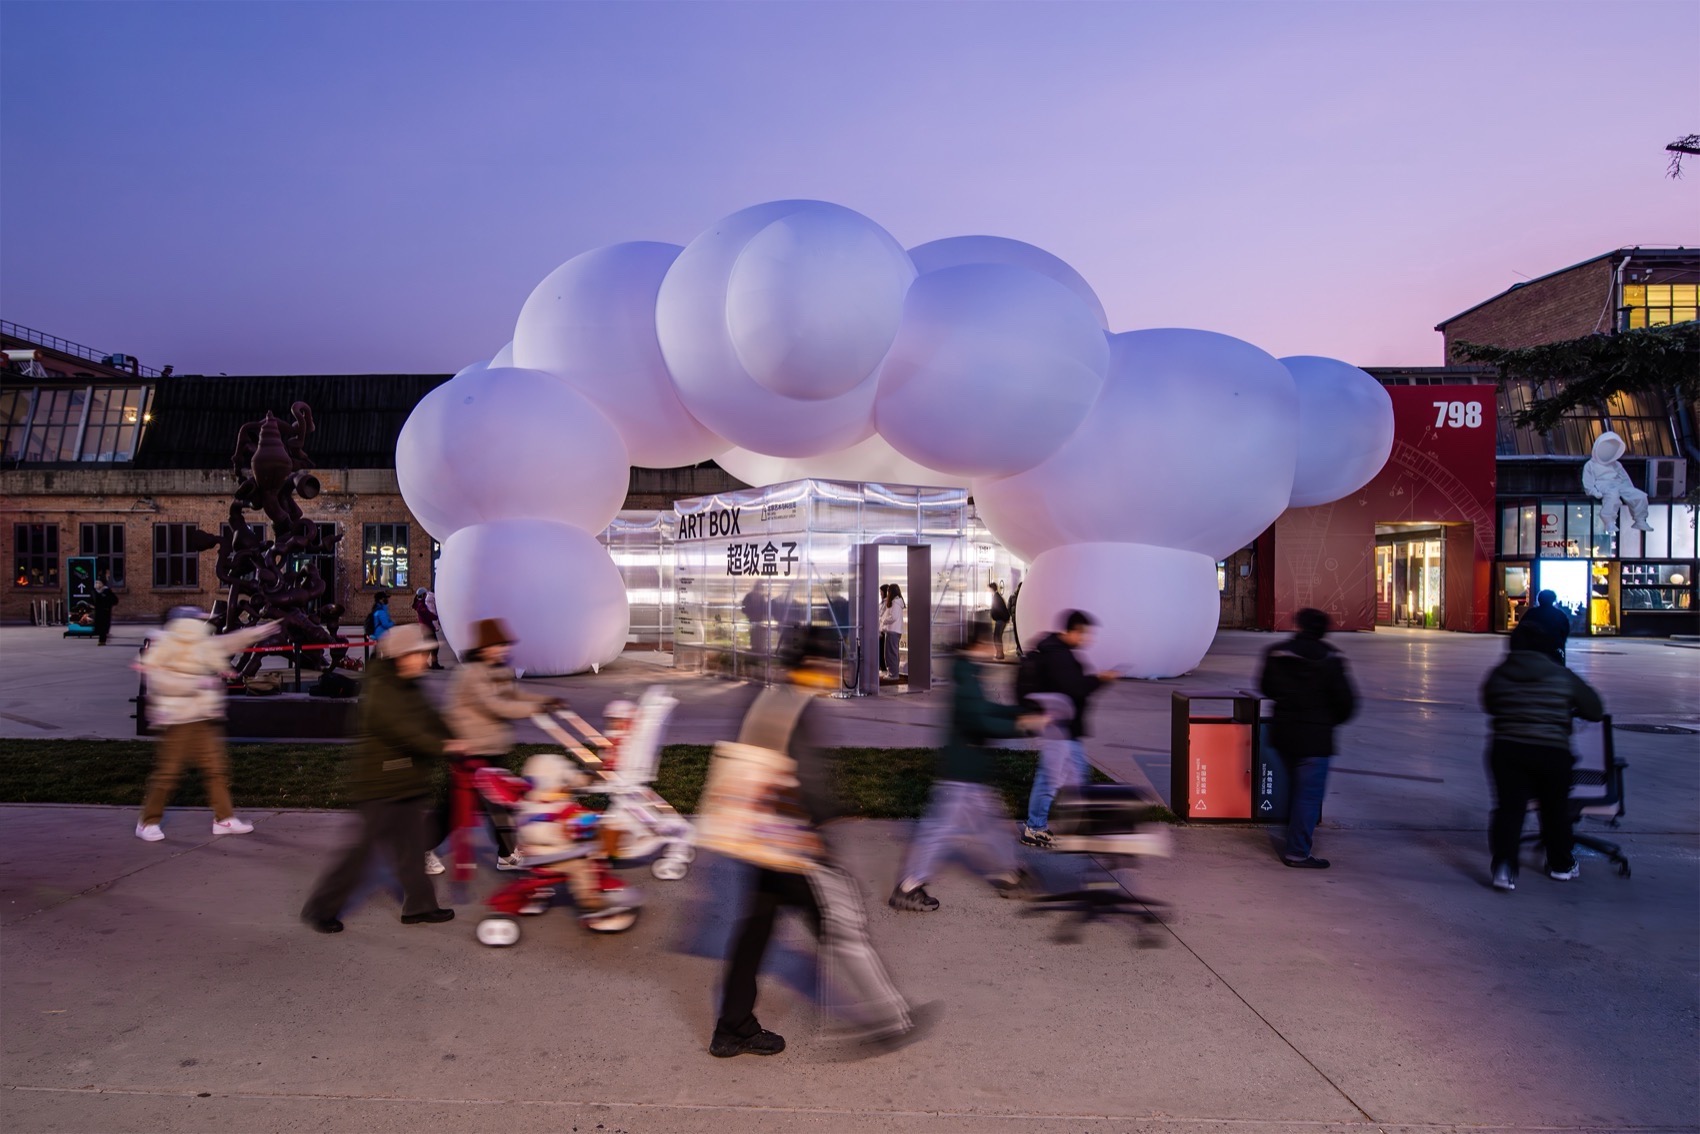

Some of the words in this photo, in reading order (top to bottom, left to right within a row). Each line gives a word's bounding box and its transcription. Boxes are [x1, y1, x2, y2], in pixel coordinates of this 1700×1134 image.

[1433, 401, 1482, 428] 798
[678, 512, 705, 539] ART
[709, 508, 740, 536] BOX
[727, 541, 798, 576] 超级盒子
